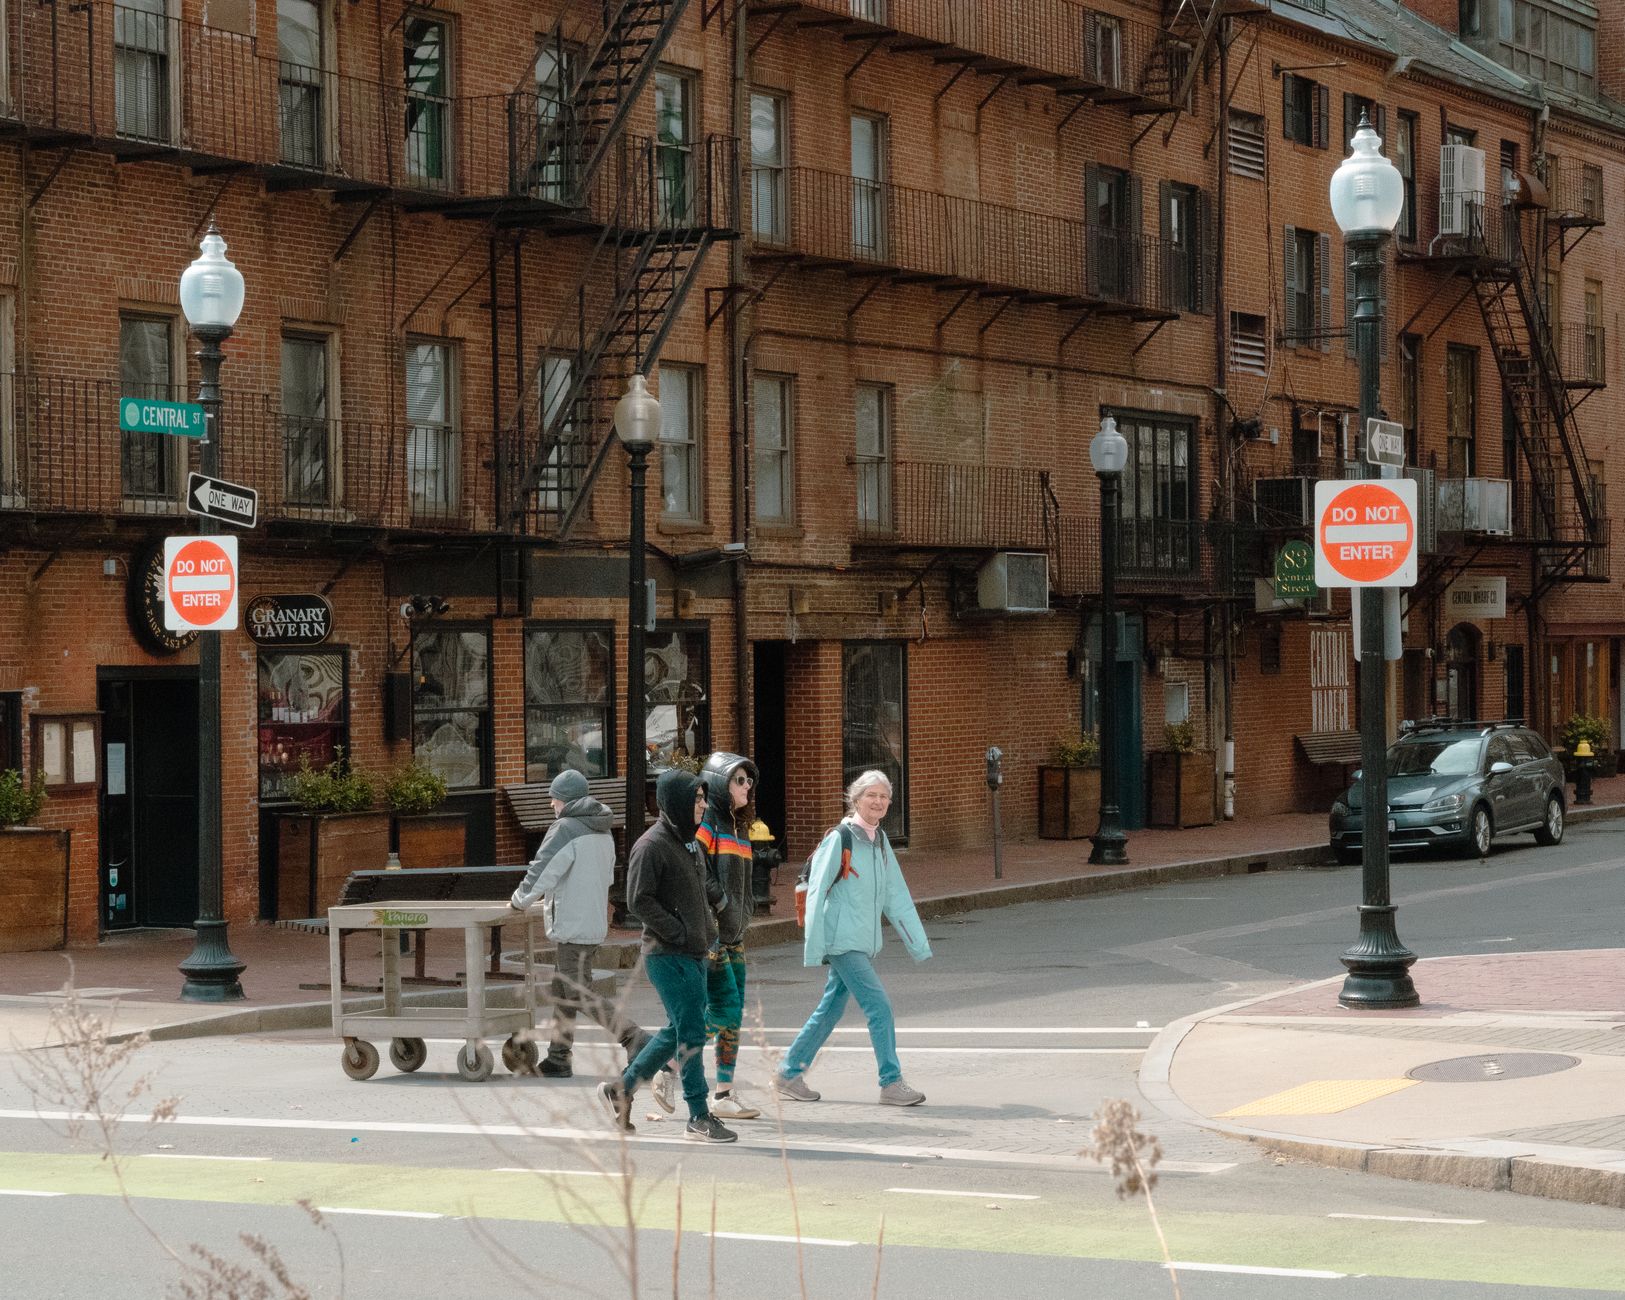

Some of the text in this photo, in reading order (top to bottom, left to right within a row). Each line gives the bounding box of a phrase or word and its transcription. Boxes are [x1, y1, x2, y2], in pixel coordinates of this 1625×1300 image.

[143, 406, 189, 428] CENTRAL
[193, 412, 200, 424] ST
[1379, 434, 1400, 453] ONE WAY
[208, 491, 250, 513] ONE WAY
[1332, 506, 1400, 522] DO NOT
[1284, 549, 1307, 568] 83
[1340, 545, 1394, 560] ENTER
[177, 559, 225, 573] DO NOT
[1281, 583, 1310, 592] Street
[182, 594, 221, 606] ENTER
[1452, 590, 1472, 604] CENTRAL
[1473, 590, 1489, 604] WHARF
[252, 608, 326, 623] GRANARY
[254, 623, 326, 637] TAVERN
[1310, 631, 1349, 687] CENTRAL
